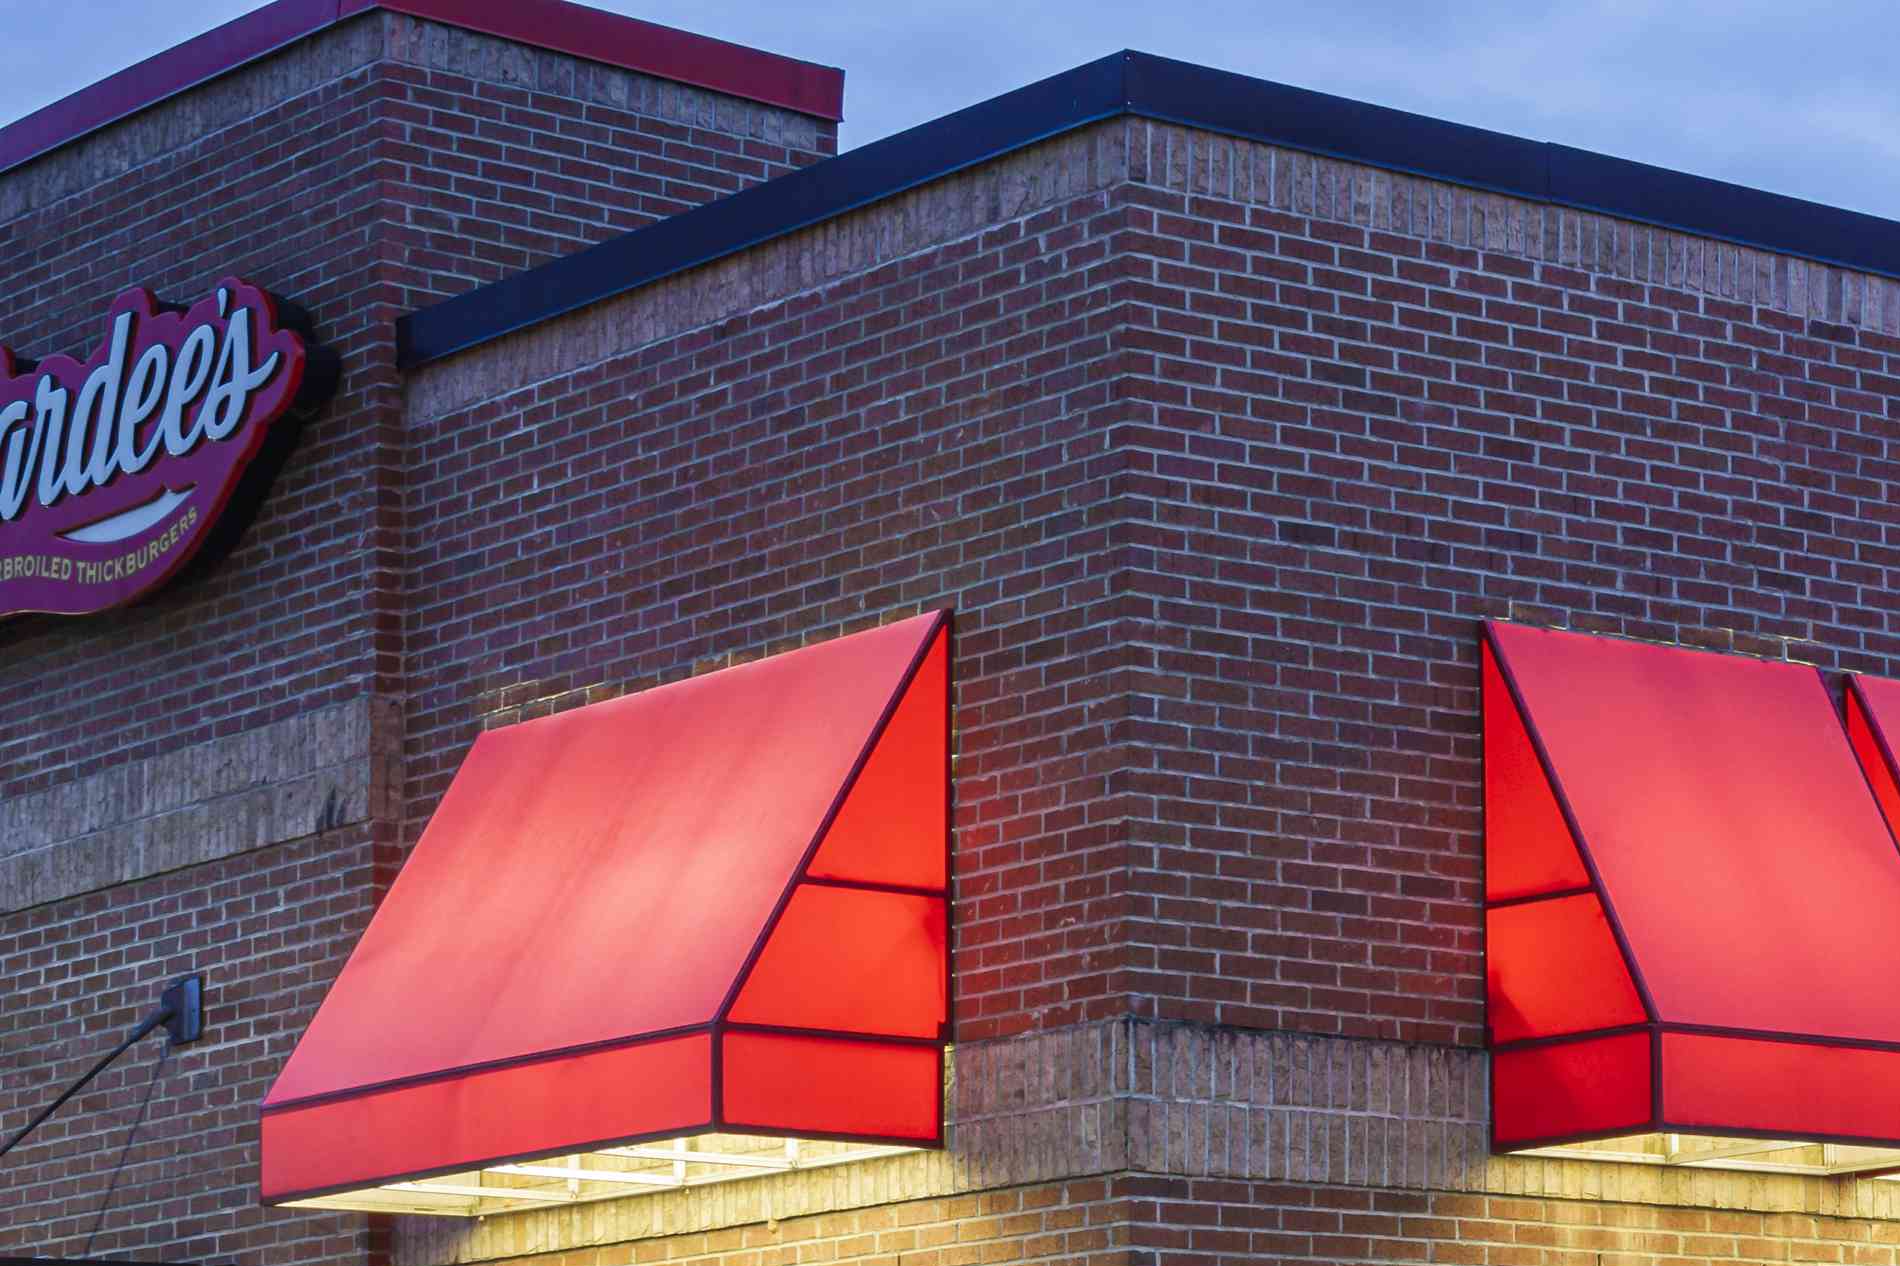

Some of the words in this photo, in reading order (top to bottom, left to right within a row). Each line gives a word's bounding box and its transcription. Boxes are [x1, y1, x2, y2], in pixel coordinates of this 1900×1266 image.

[0, 287, 278, 520] ardee's
[0, 556, 71, 581] BROILED
[77, 506, 198, 584] THICKBURGERS
